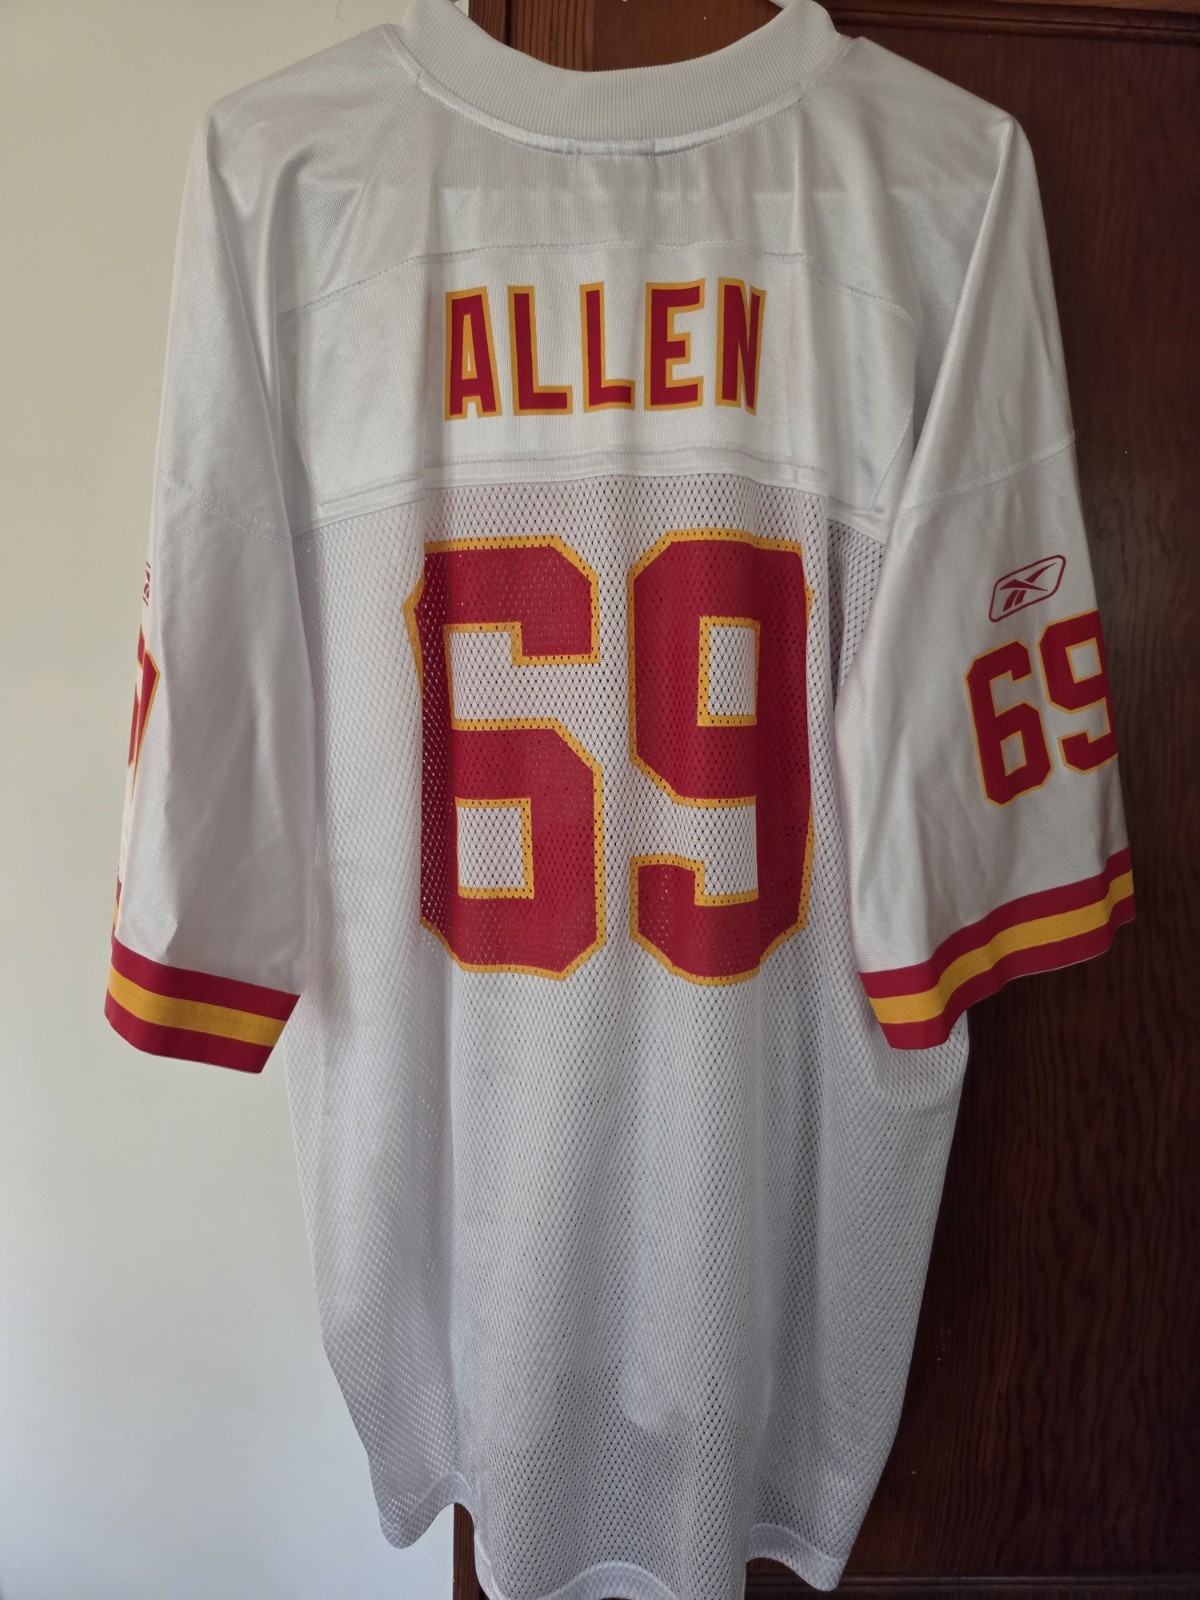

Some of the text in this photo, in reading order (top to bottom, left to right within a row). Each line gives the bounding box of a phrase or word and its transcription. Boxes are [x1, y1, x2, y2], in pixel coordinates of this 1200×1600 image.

[445, 277, 766, 421] ALLEN
[403, 527, 815, 986] 69
[965, 608, 1118, 807] 69
